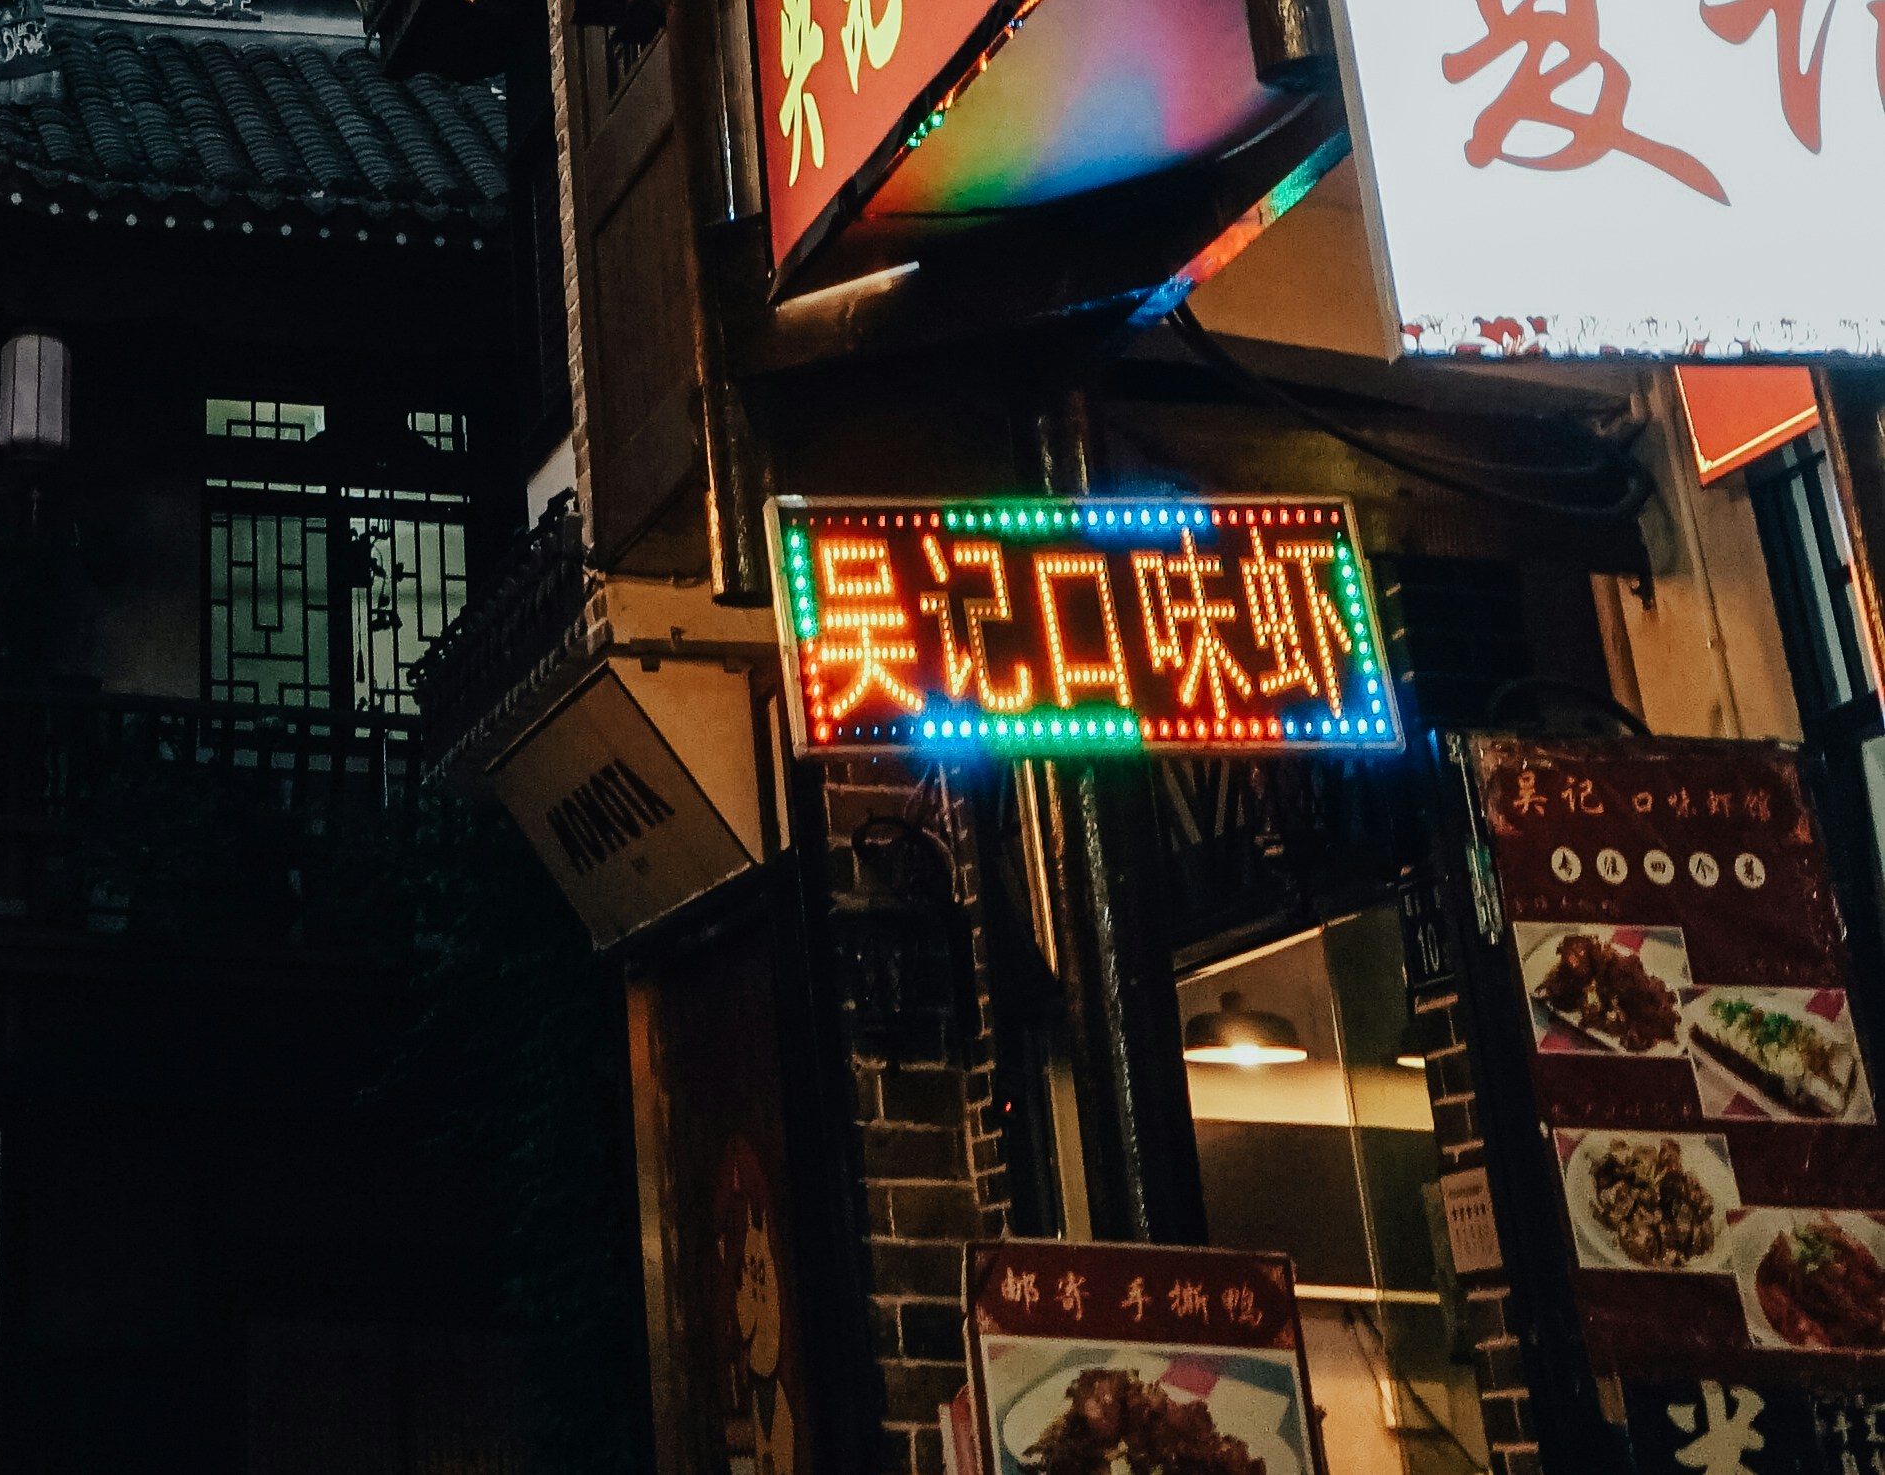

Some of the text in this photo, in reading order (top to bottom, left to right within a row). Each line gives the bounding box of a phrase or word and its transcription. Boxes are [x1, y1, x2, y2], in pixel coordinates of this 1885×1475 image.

[818, 525, 1353, 722] 吴记口味虾
